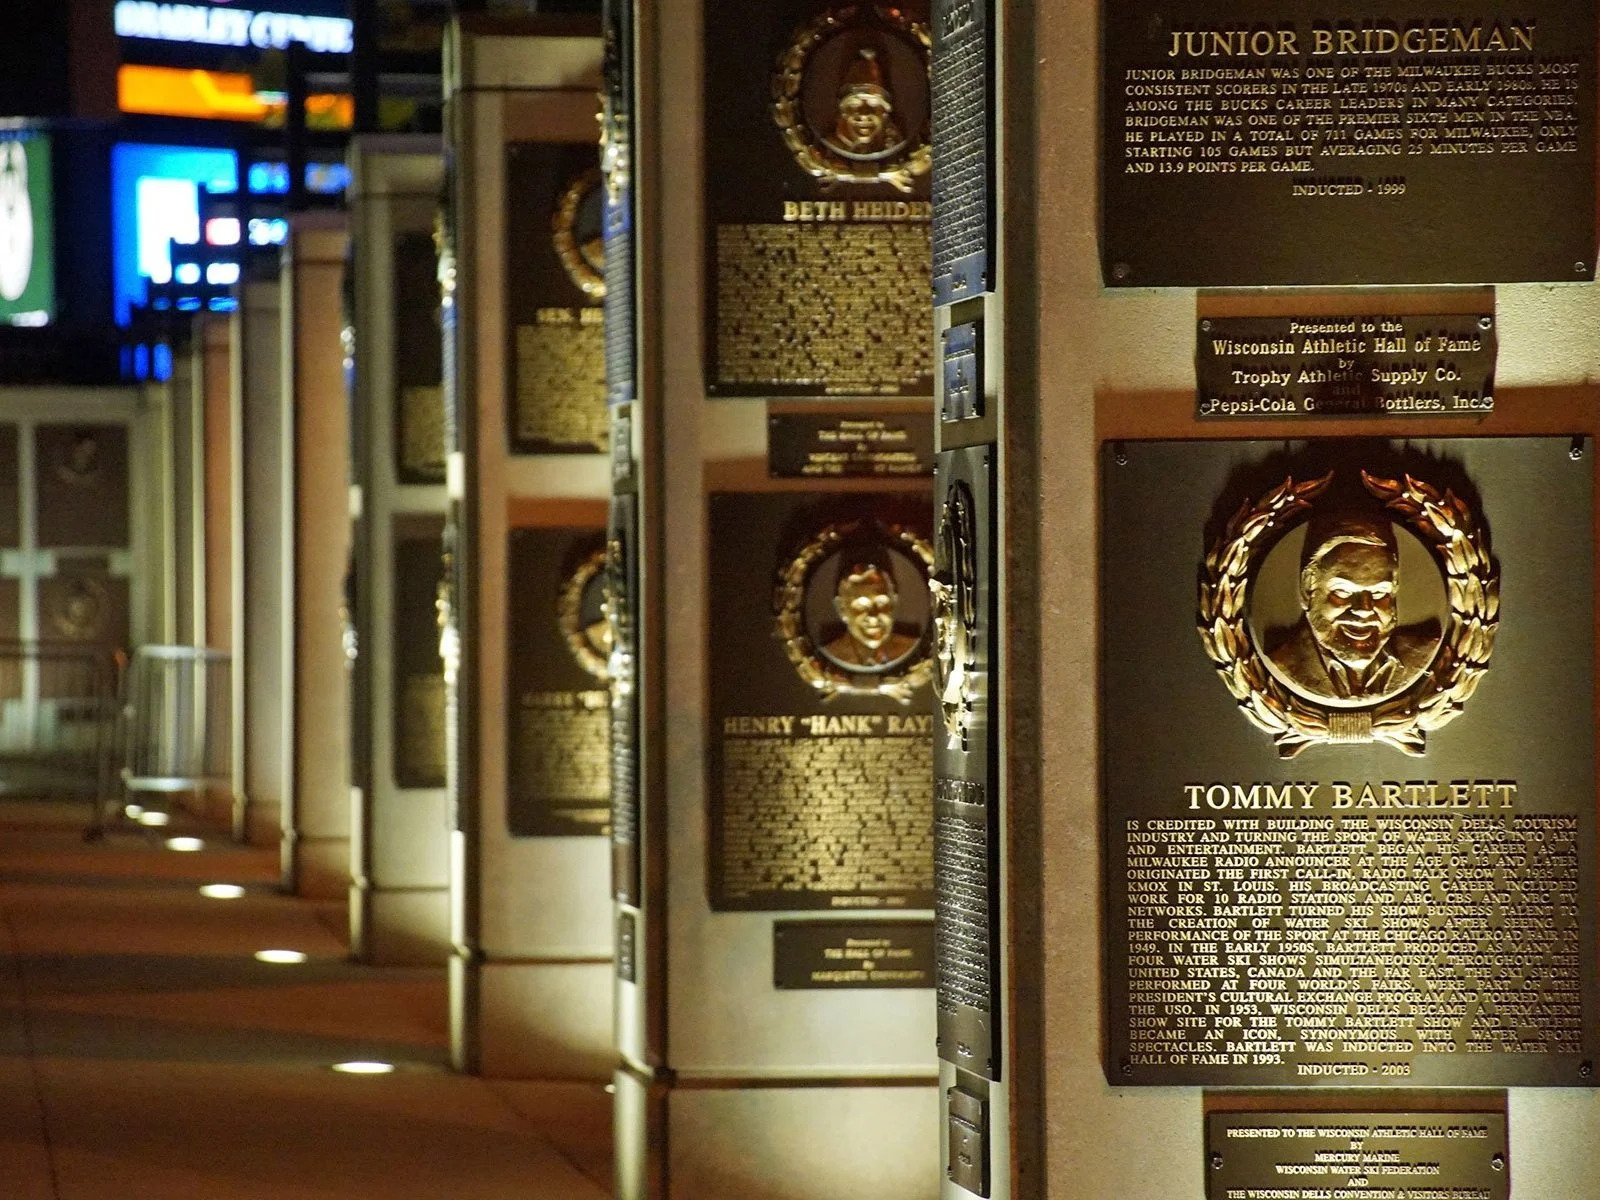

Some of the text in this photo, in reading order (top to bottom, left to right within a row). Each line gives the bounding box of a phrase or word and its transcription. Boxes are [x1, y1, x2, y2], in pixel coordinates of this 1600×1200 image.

[1168, 26, 1534, 56] JUNIOR BRIDGEMAN
[1125, 66, 1391, 80] JUNIOR BRIDGEMAN WAS ONE OF THE
[1125, 83, 1276, 96] CONSISTENT SCORERS
[1125, 100, 1177, 111] AMONG
[1184, 100, 1212, 111] THE
[1220, 99, 1267, 110] BUCKS
[1275, 98, 1331, 110] CAREER
[1339, 98, 1403, 109] LEADERS
[1411, 97, 1428, 108] IN
[1125, 128, 1402, 142] HE PLAYED IN A TOTAL OF 711 GAMES
[1125, 146, 1192, 158] STARTING
[1200, 146, 1221, 157] 105
[1228, 145, 1277, 156] GAMES
[1284, 145, 1312, 156] BUT
[1320, 144, 1400, 155] AVERAGING
[1407, 144, 1422, 154] 25
[1125, 162, 1154, 172] AND
[1159, 162, 1183, 172] 13.9
[1187, 161, 1236, 172] POINTS
[1240, 161, 1266, 172] PER
[1293, 184, 1405, 195] INDUCTED 1999
[783, 201, 846, 221] BETH
[1290, 322, 1403, 334] Presented to the
[1212, 338, 1481, 355] Wisconsin Athletic Hall of Fame
[1339, 358, 1354, 370] by
[1232, 371, 1290, 386] Trophy
[1371, 369, 1426, 384] Supply
[1210, 399, 1296, 414] Pepsi-Cola
[724, 716, 796, 735] HENRY
[887, 715, 933, 734] RAY
[1184, 785, 1517, 810] TOMMY BARTLETT
[1127, 820, 1368, 830] IS CREDITED WITH BUILDING THE
[1127, 845, 1156, 855] AND
[1296, 844, 1366, 854] BARTLETT
[1127, 869, 1210, 880] ORIGINATED
[1216, 869, 1244, 879] THE
[1249, 869, 1289, 879] FIRST
[1127, 882, 1167, 892] KMOX
[1177, 882, 1193, 892] IN
[1288, 881, 1311, 892] HIS
[1212, 906, 1283, 916] BARTLETT
[1288, 906, 1344, 916] TURNED
[1350, 906, 1373, 916] HIS
[1128, 930, 1380, 941] PERFORMANCE OF THE SPORT AT THE
[1128, 968, 1179, 978] UNITED
[1247, 968, 1304, 978] CANADA
[1312, 968, 1342, 978] AND
[1348, 968, 1377, 978] THE
[1128, 980, 1360, 990] PERFORMED AT FOUR WORLD'S
[1129, 992, 1372, 1003] PRESIDENT'S CULTURAL EXCHANGE
[1129, 1005, 1155, 1015] THE
[1204, 1005, 1220, 1015] IN
[1270, 1005, 1350, 1015] WISCONSIN
[1129, 1017, 1336, 1027] SHOW SITE FOR THE TOMMY
[1225, 1042, 1296, 1052] BARTLETT
[1304, 1042, 1333, 1052] WAS
[1130, 1055, 1165, 1064] HALL
[1169, 1055, 1188, 1064] OF
[1191, 1055, 1229, 1064] FAME
[1232, 1055, 1248, 1064] IN
[1297, 1065, 1410, 1075] INDUCTED 2003
[1227, 1129, 1280, 1138] PRESENTED
[1281, 1129, 1295, 1138] TO
[1296, 1129, 1315, 1138] THE
[1317, 1129, 1369, 1138] WISCONSIN
[1371, 1129, 1416, 1138] ATHLETIC
[1420, 1130, 1444, 1138] HALL
[1350, 1142, 1364, 1150] BY
[1314, 1154, 1399, 1162] MERCURY MARINE
[1276, 1166, 1438, 1174] WISCONSIN WATER SKI FEDERATION
[1348, 1178, 1368, 1186] AND
[1227, 1190, 1245, 1199] THE
[1247, 1190, 1299, 1199] WISCONSIN
[1302, 1190, 1330, 1199] DELLS
[1333, 1190, 1394, 1199] CONVENTION
[1406, 1190, 1449, 1199] VISITORS
